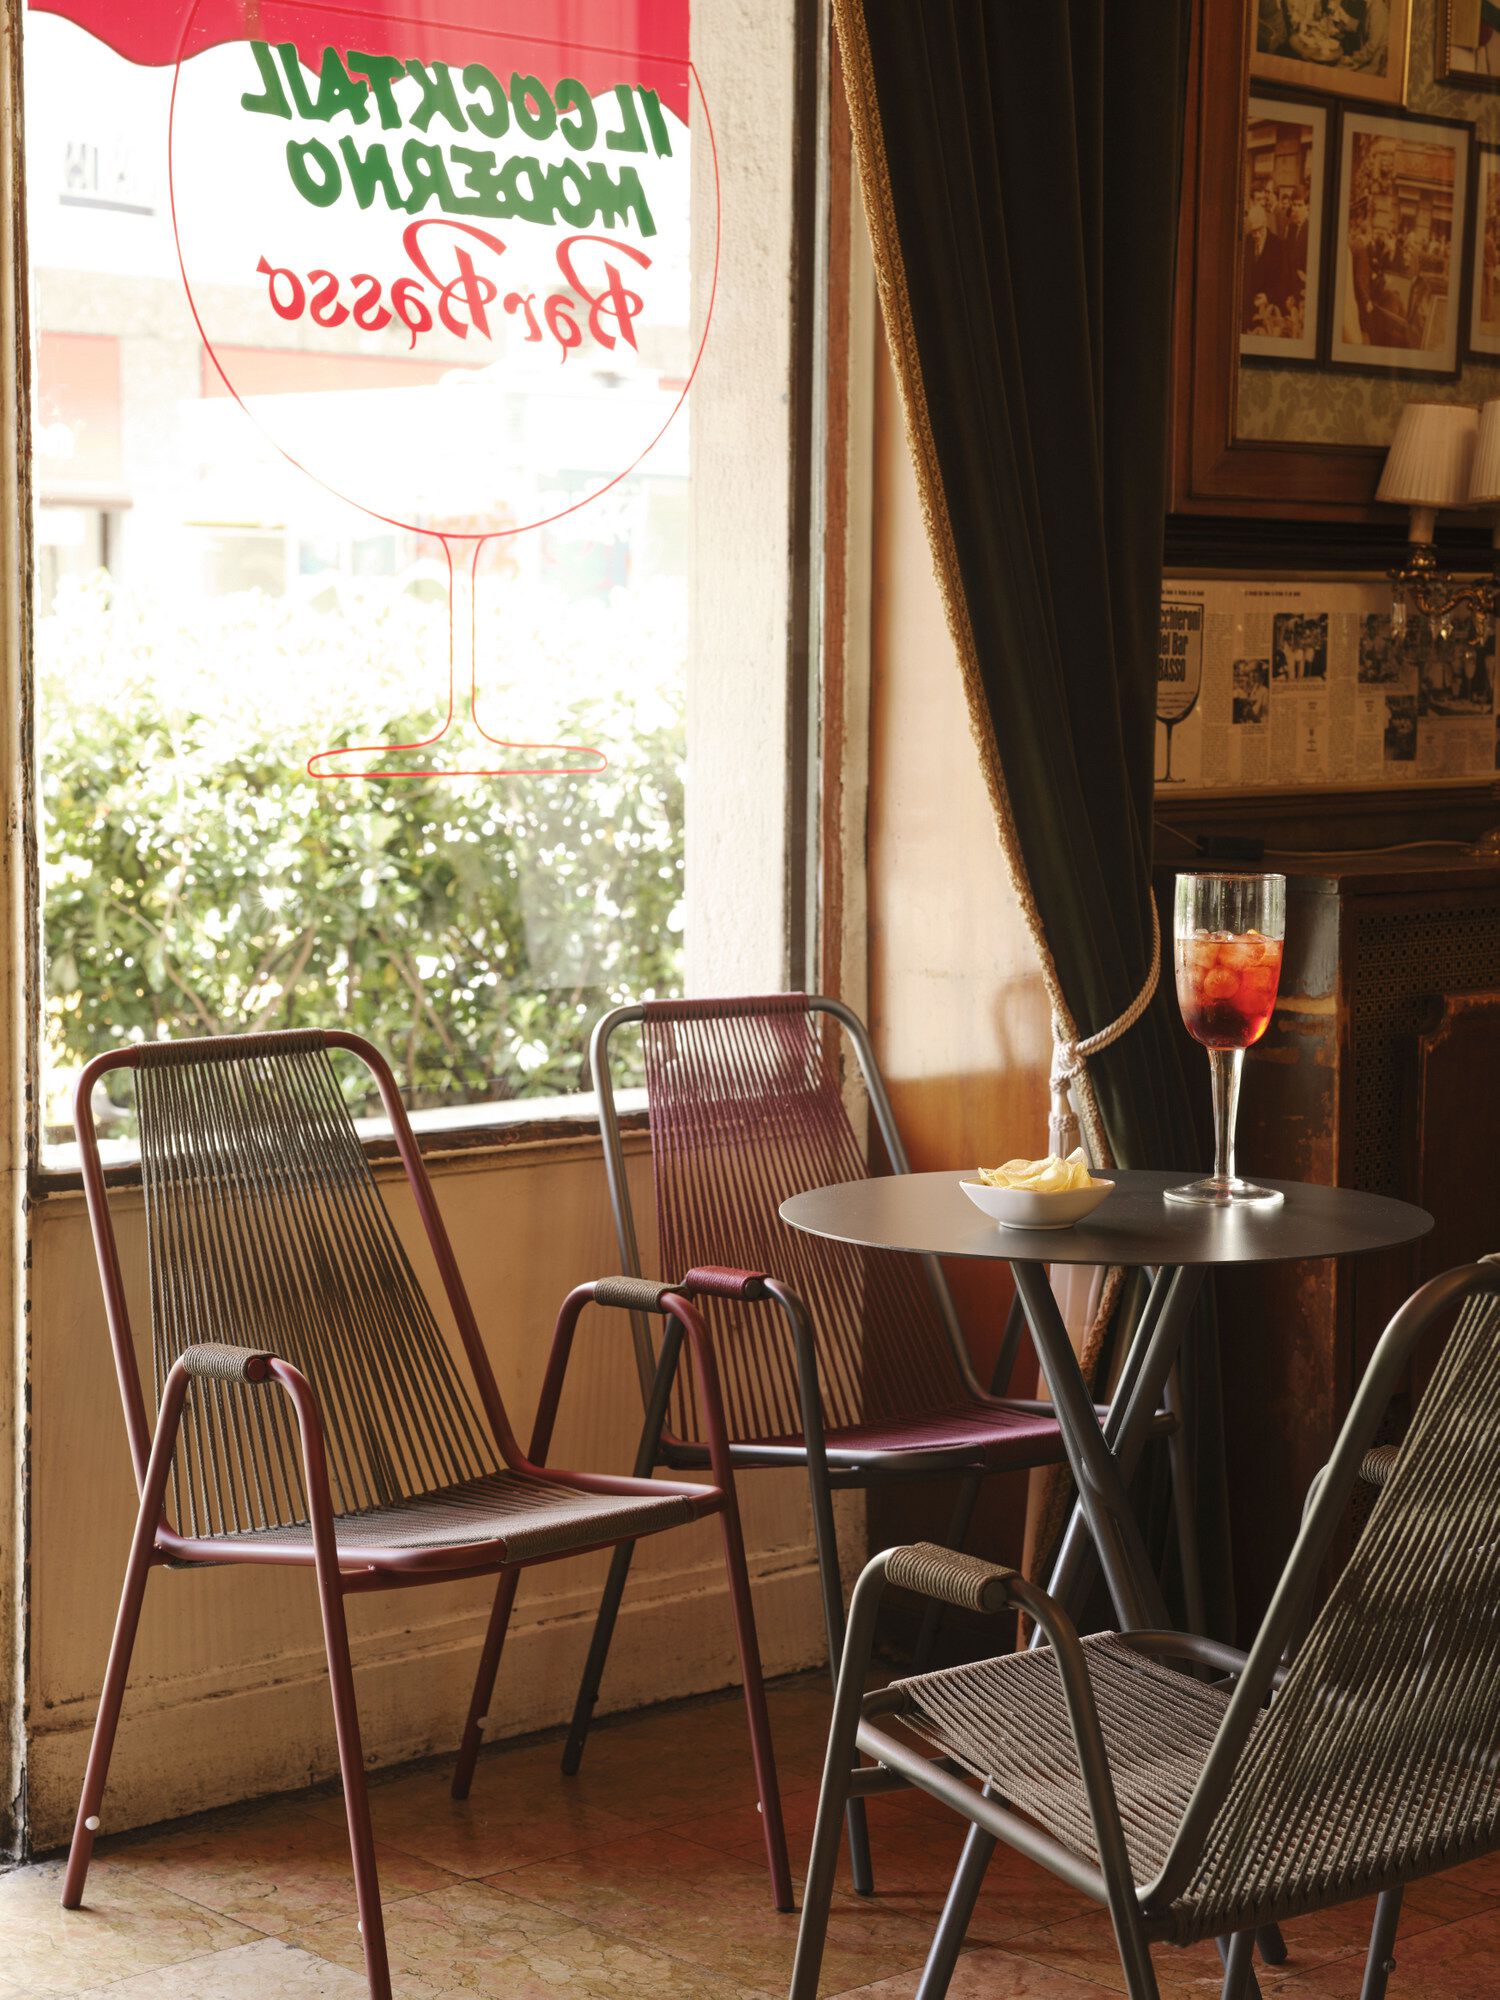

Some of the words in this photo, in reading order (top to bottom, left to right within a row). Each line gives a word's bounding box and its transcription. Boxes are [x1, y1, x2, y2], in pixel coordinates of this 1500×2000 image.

[1159, 606, 1200, 631] cchieroni
[1172, 631, 1188, 656] Bar
[1158, 657, 1186, 682] BASSO
